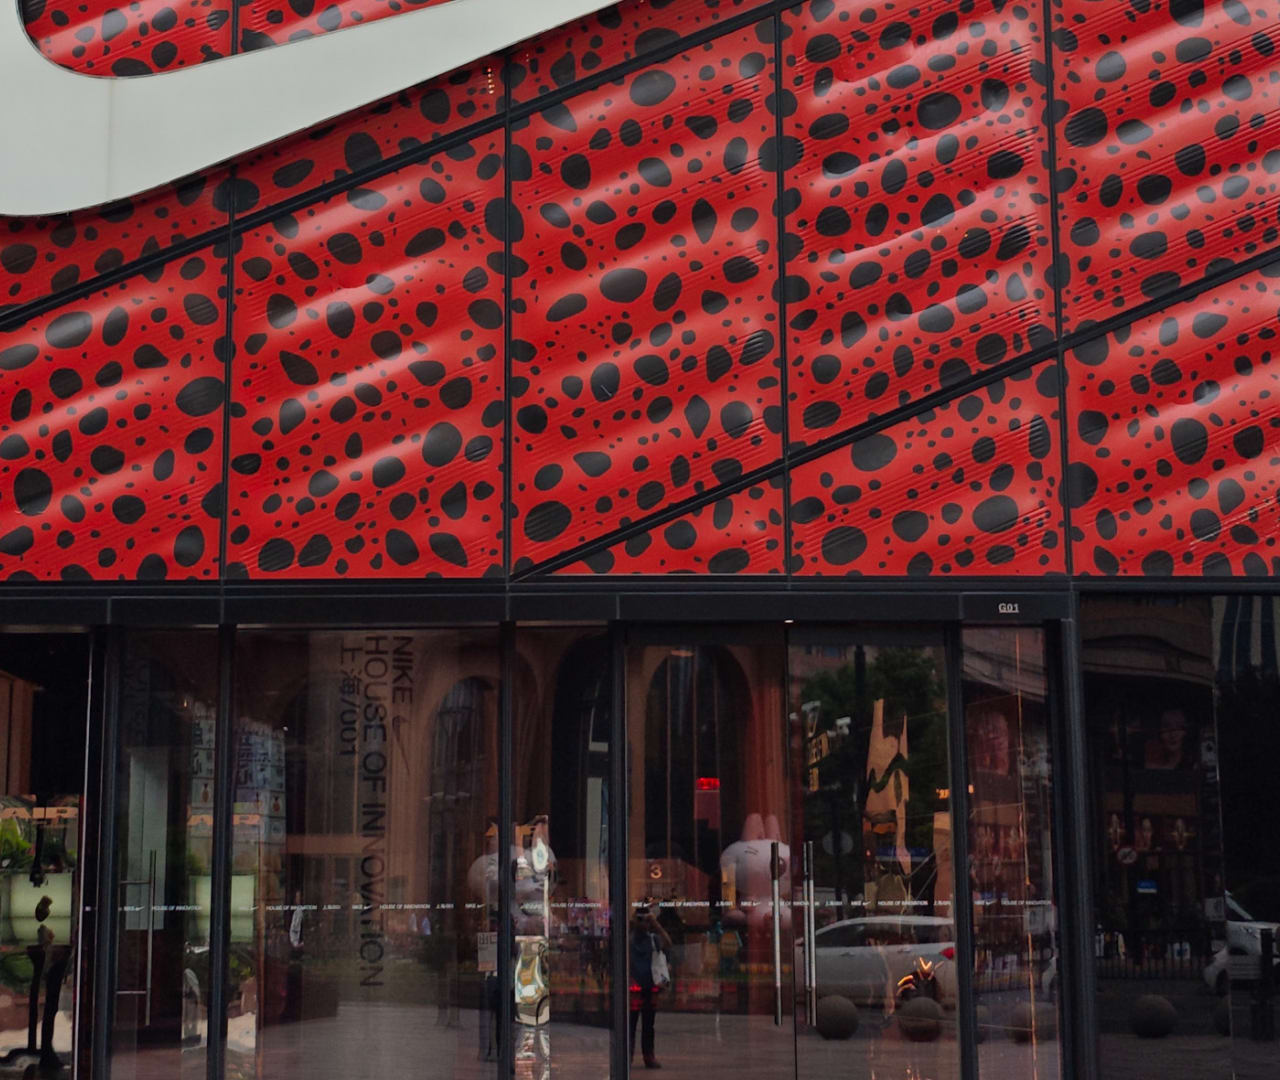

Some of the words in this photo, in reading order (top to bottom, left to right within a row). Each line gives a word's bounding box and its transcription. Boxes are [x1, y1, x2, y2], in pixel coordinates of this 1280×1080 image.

[998, 602, 1020, 614] G01
[363, 635, 388, 743] HOUSE
[392, 635, 414, 705] NIKE
[363, 751, 387, 793] OF
[359, 803, 386, 987] INNOVATION
[650, 863, 663, 879] 3
